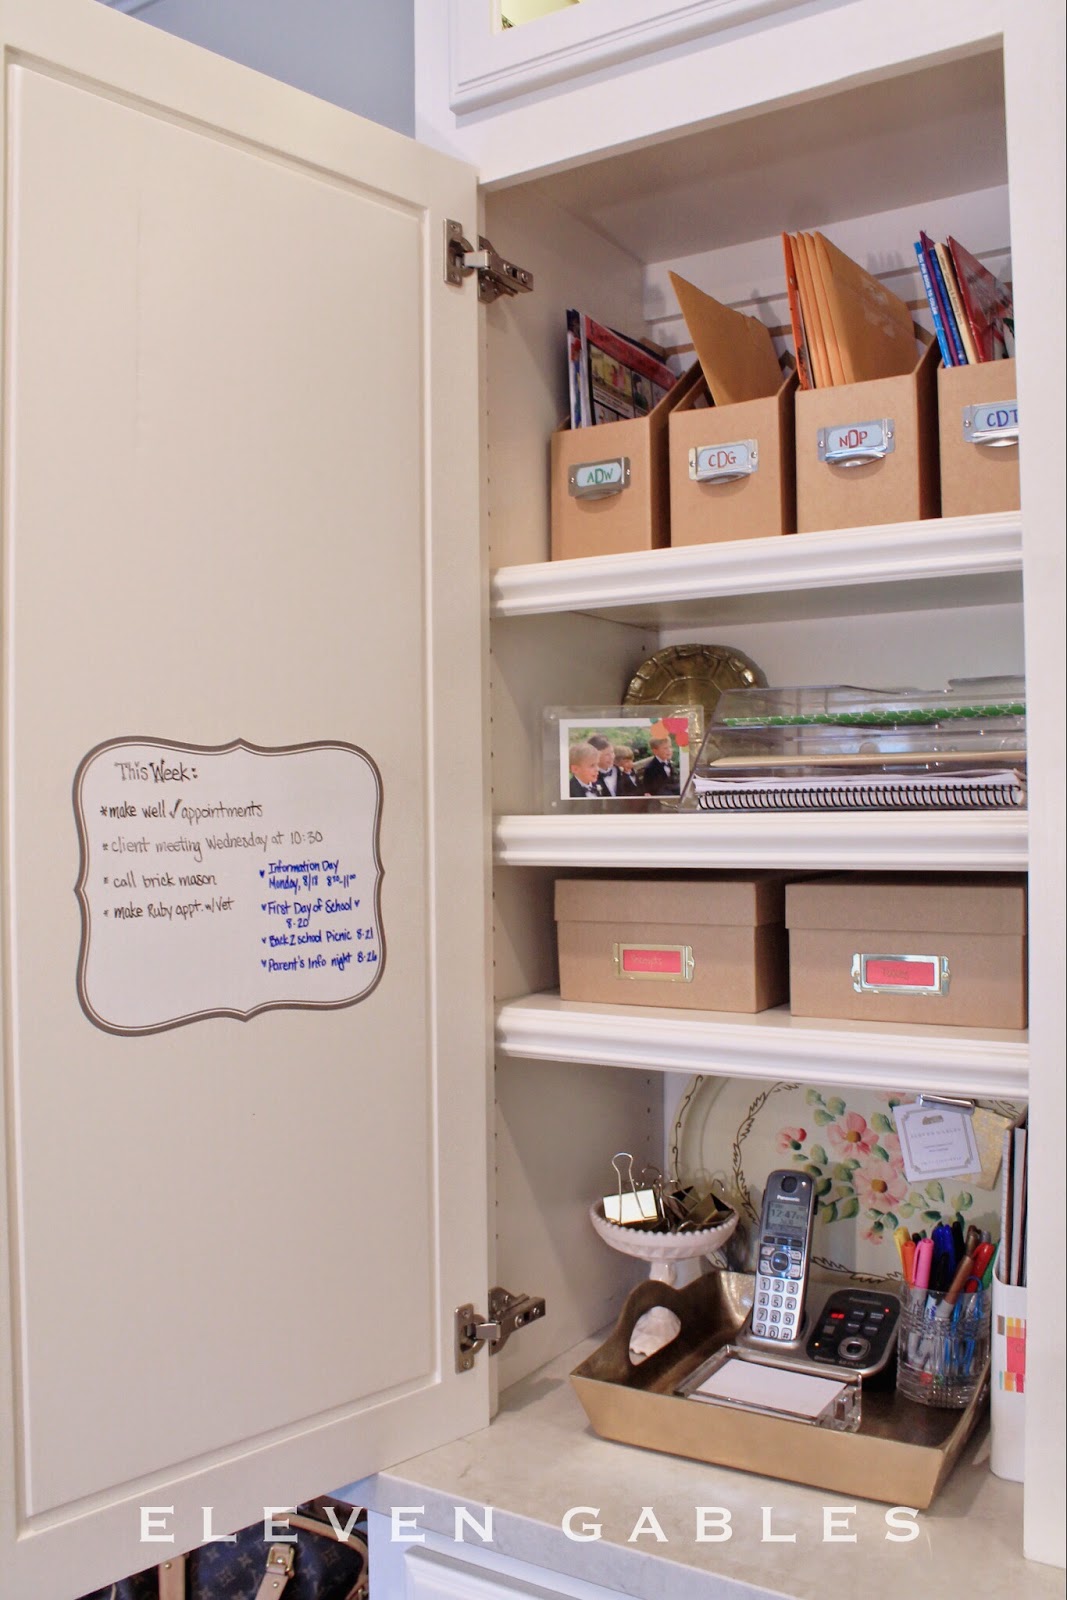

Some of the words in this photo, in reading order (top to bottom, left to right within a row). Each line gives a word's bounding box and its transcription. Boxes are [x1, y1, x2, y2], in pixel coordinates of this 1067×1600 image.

[839, 429, 867, 449] NDP
[708, 450, 737, 469] CDG
[587, 468, 613, 485] ADW
[114, 761, 149, 781] This
[149, 758, 199, 783] Week:
[109, 801, 137, 819] make
[141, 800, 166, 818] well
[181, 801, 264, 826] appointments
[111, 836, 150, 854] client
[156, 836, 203, 863] meeting
[205, 832, 268, 852] Wednesday
[271, 832, 284, 845] at
[290, 831, 324, 845] 10:30
[268, 859, 320, 875] Information
[321, 859, 340, 875] Day
[113, 870, 137, 888] call
[142, 872, 176, 888] brick
[178, 873, 218, 886] mason
[114, 901, 144, 919] make
[147, 901, 173, 920] Ruby
[175, 899, 203, 920] appt.
[267, 899, 291, 915] First
[293, 901, 312, 921] Day
[312, 898, 323, 913] of
[324, 896, 353, 914] School
[269, 934, 289, 948] Back
[297, 929, 322, 945] school
[326, 928, 352, 943] Picnic
[268, 955, 305, 972] Parent's
[308, 954, 327, 970] Info
[331, 951, 352, 971] night
